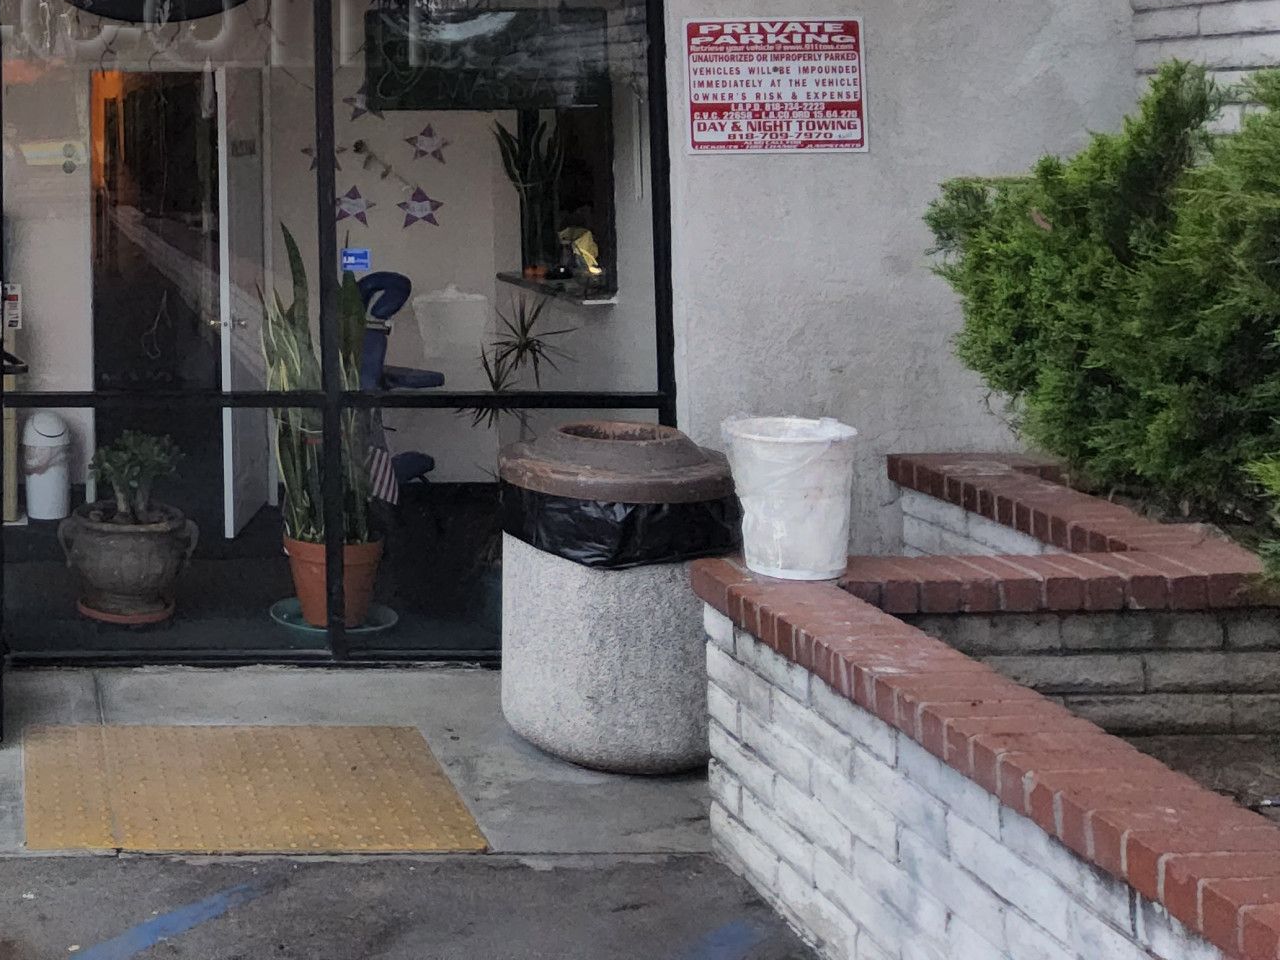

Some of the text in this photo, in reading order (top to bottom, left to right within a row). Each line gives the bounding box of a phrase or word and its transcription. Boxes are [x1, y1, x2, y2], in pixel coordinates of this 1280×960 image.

[699, 22, 845, 34] PRIVATE
[690, 33, 857, 45] PARKING
[691, 52, 857, 63] UNAUTHORIZED OR IMPROPERLY PARKED
[692, 65, 858, 76] VEHICLES WILL BE IMPOUNDED
[692, 78, 859, 89] IMMEDIATELY AT THE VEHICLE
[693, 91, 860, 102] OWNER'S RISK & EXPENSE
[697, 119, 858, 133] DAY & NIGHT TOWING
[727, 132, 834, 141] 818-709-7970
